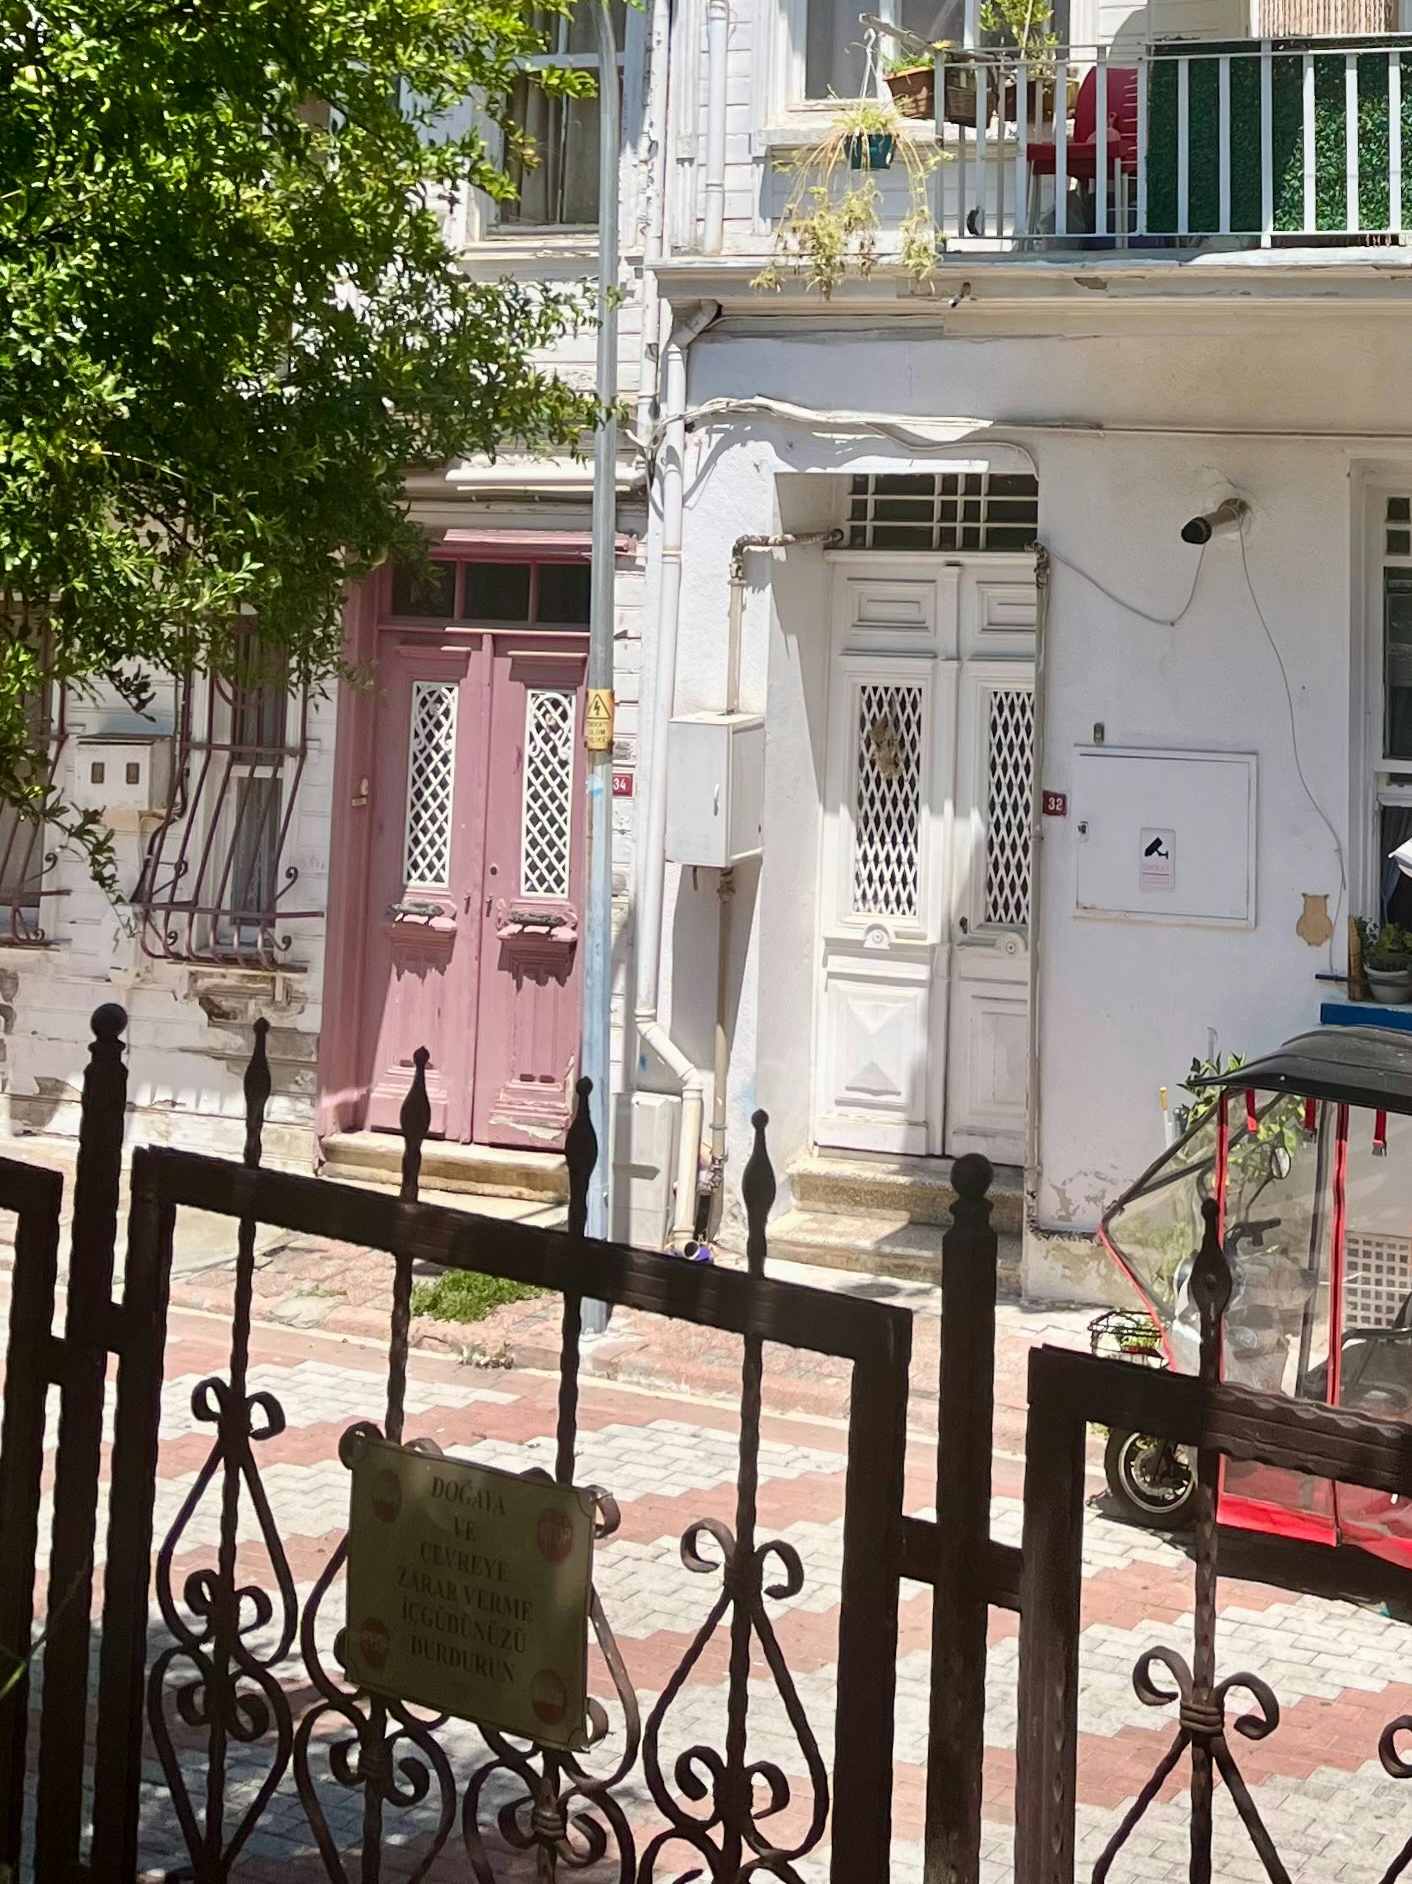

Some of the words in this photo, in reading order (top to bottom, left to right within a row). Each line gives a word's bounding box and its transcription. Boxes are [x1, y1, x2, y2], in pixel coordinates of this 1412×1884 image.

[613, 777, 627, 791] 34
[1048, 797, 1063, 811] 32
[431, 1477, 506, 1516] DOĞAYA
[453, 1517, 477, 1541] VE
[397, 1566, 459, 1602] ZARAR
[464, 1585, 533, 1622] VERME
[411, 1635, 515, 1684] DURDURUN
